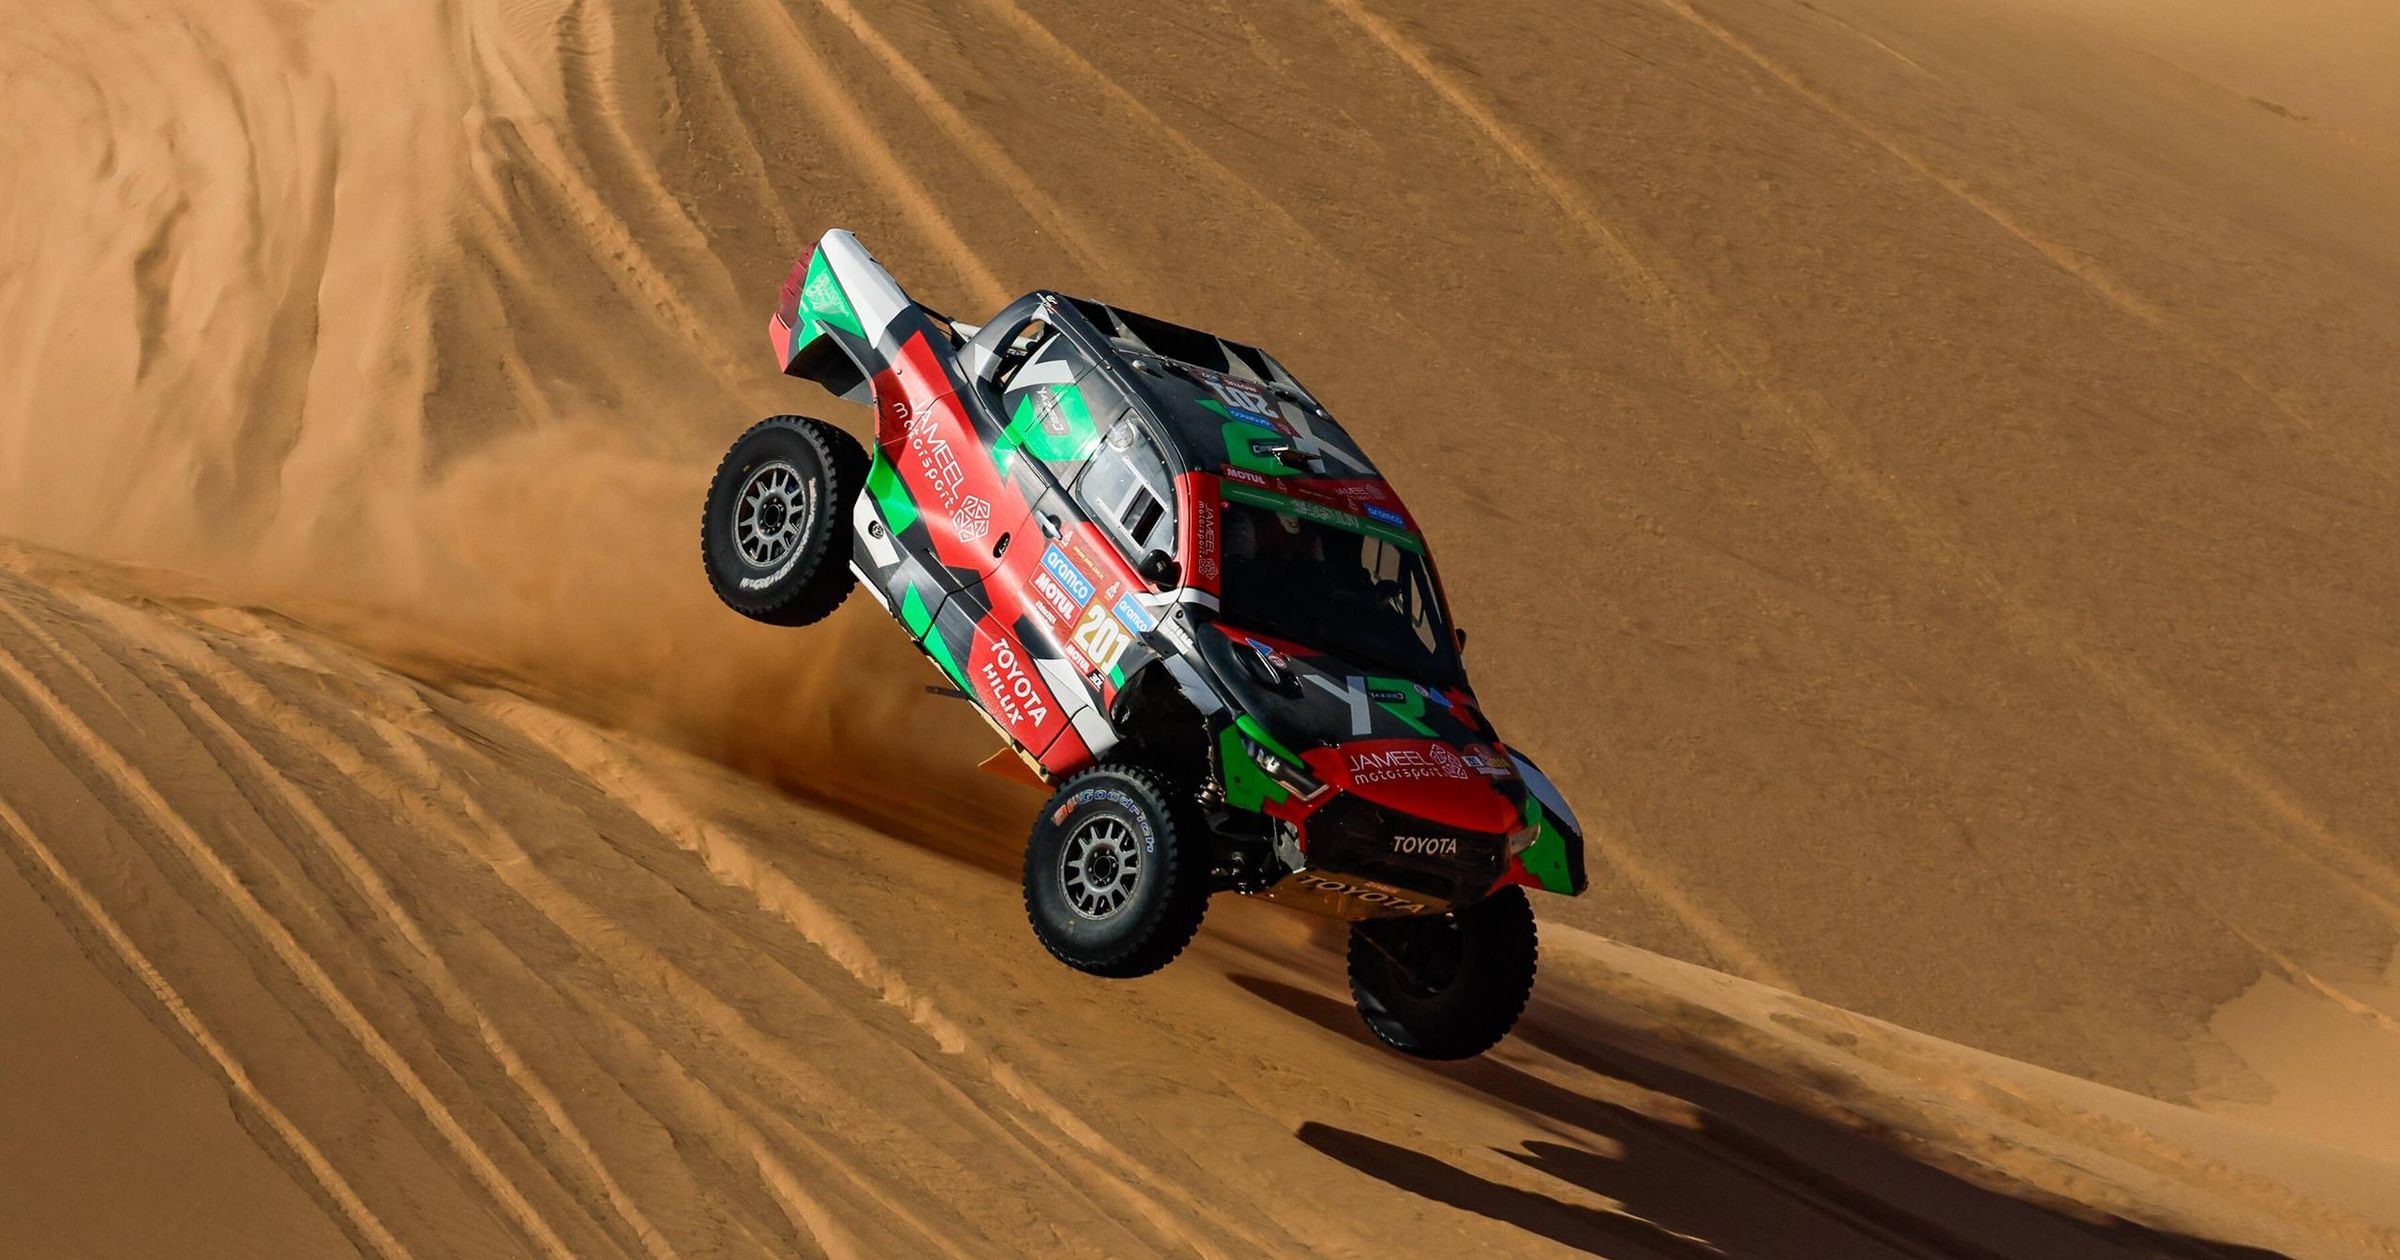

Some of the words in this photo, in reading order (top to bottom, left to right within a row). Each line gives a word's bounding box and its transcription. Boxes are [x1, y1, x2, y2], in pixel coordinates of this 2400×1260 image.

[1204, 380, 1280, 419] 201
[913, 400, 965, 500] JAMEEL
[1226, 467, 1266, 485] MOTUL
[1205, 502, 1215, 556] JAMEEL
[1034, 572, 1075, 621] MOTUL
[1047, 551, 1089, 599] aramco
[1119, 601, 1148, 631] aramco
[1064, 644, 1091, 673] MOTUL
[1073, 604, 1131, 675] 201
[982, 663, 1024, 725] HILUX
[991, 638, 1047, 727] TOYOTA
[1350, 750, 1435, 772] JAMEEL
[1393, 836, 1457, 854] TOYOTA
[1300, 875, 1425, 913] TOYOTA
